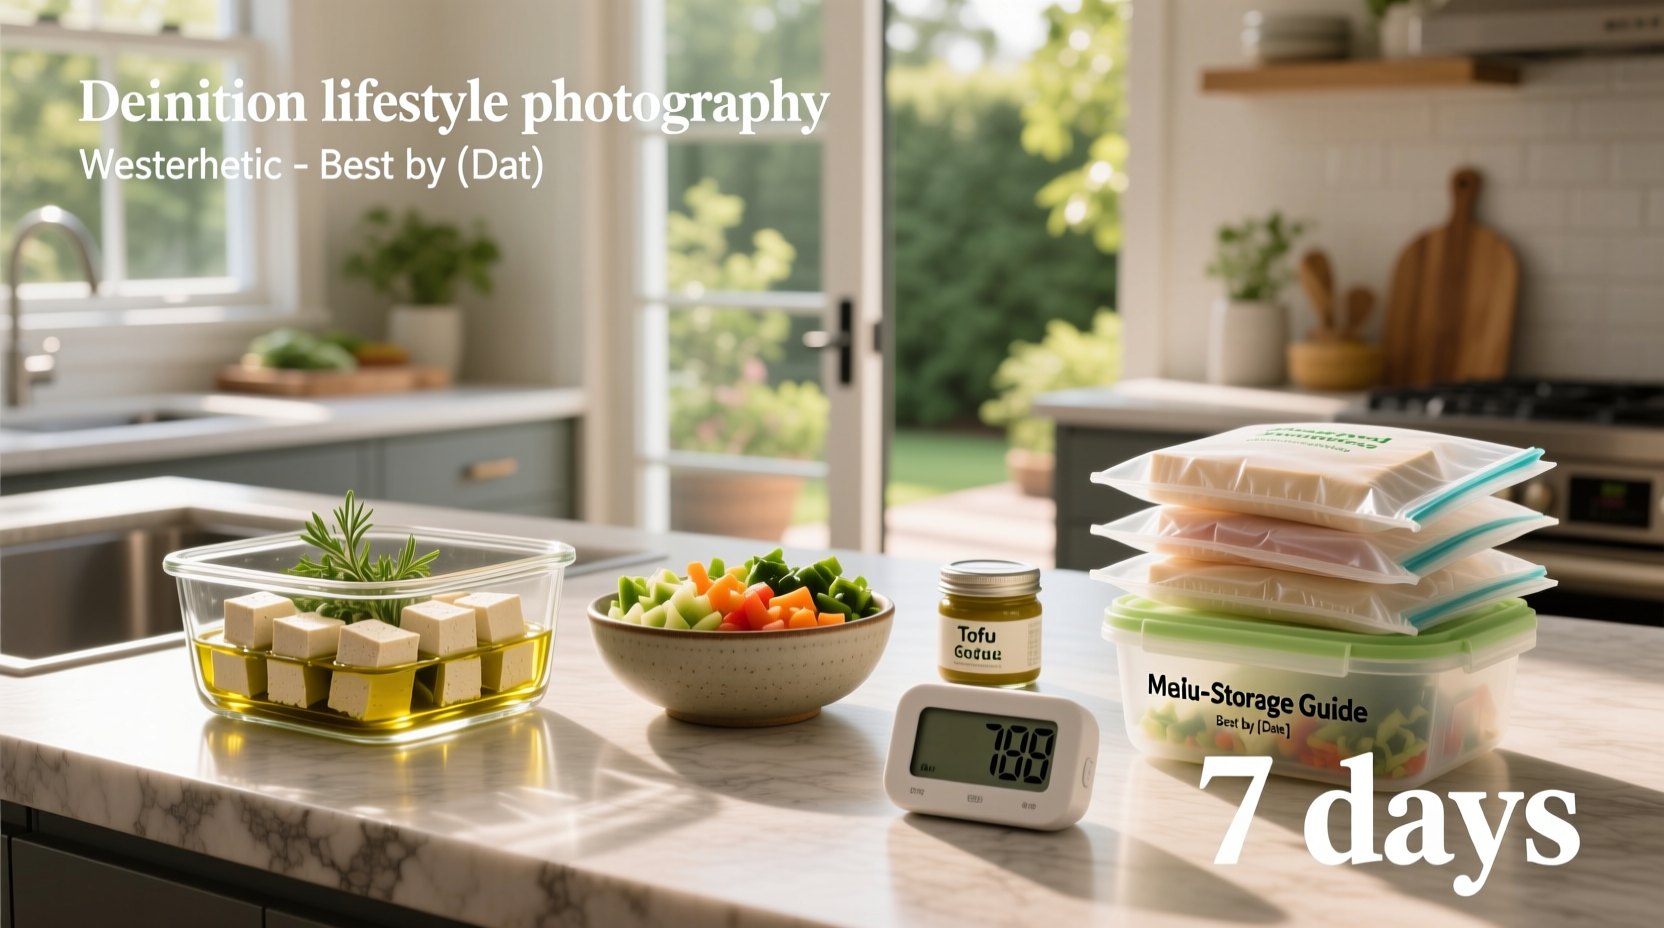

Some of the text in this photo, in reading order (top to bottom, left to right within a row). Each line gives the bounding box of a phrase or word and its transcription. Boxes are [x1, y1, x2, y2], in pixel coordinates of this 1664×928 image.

[957, 625, 996, 644] Tofu
[1299, 693, 1369, 723] Guide
[985, 723, 1055, 785] 788
